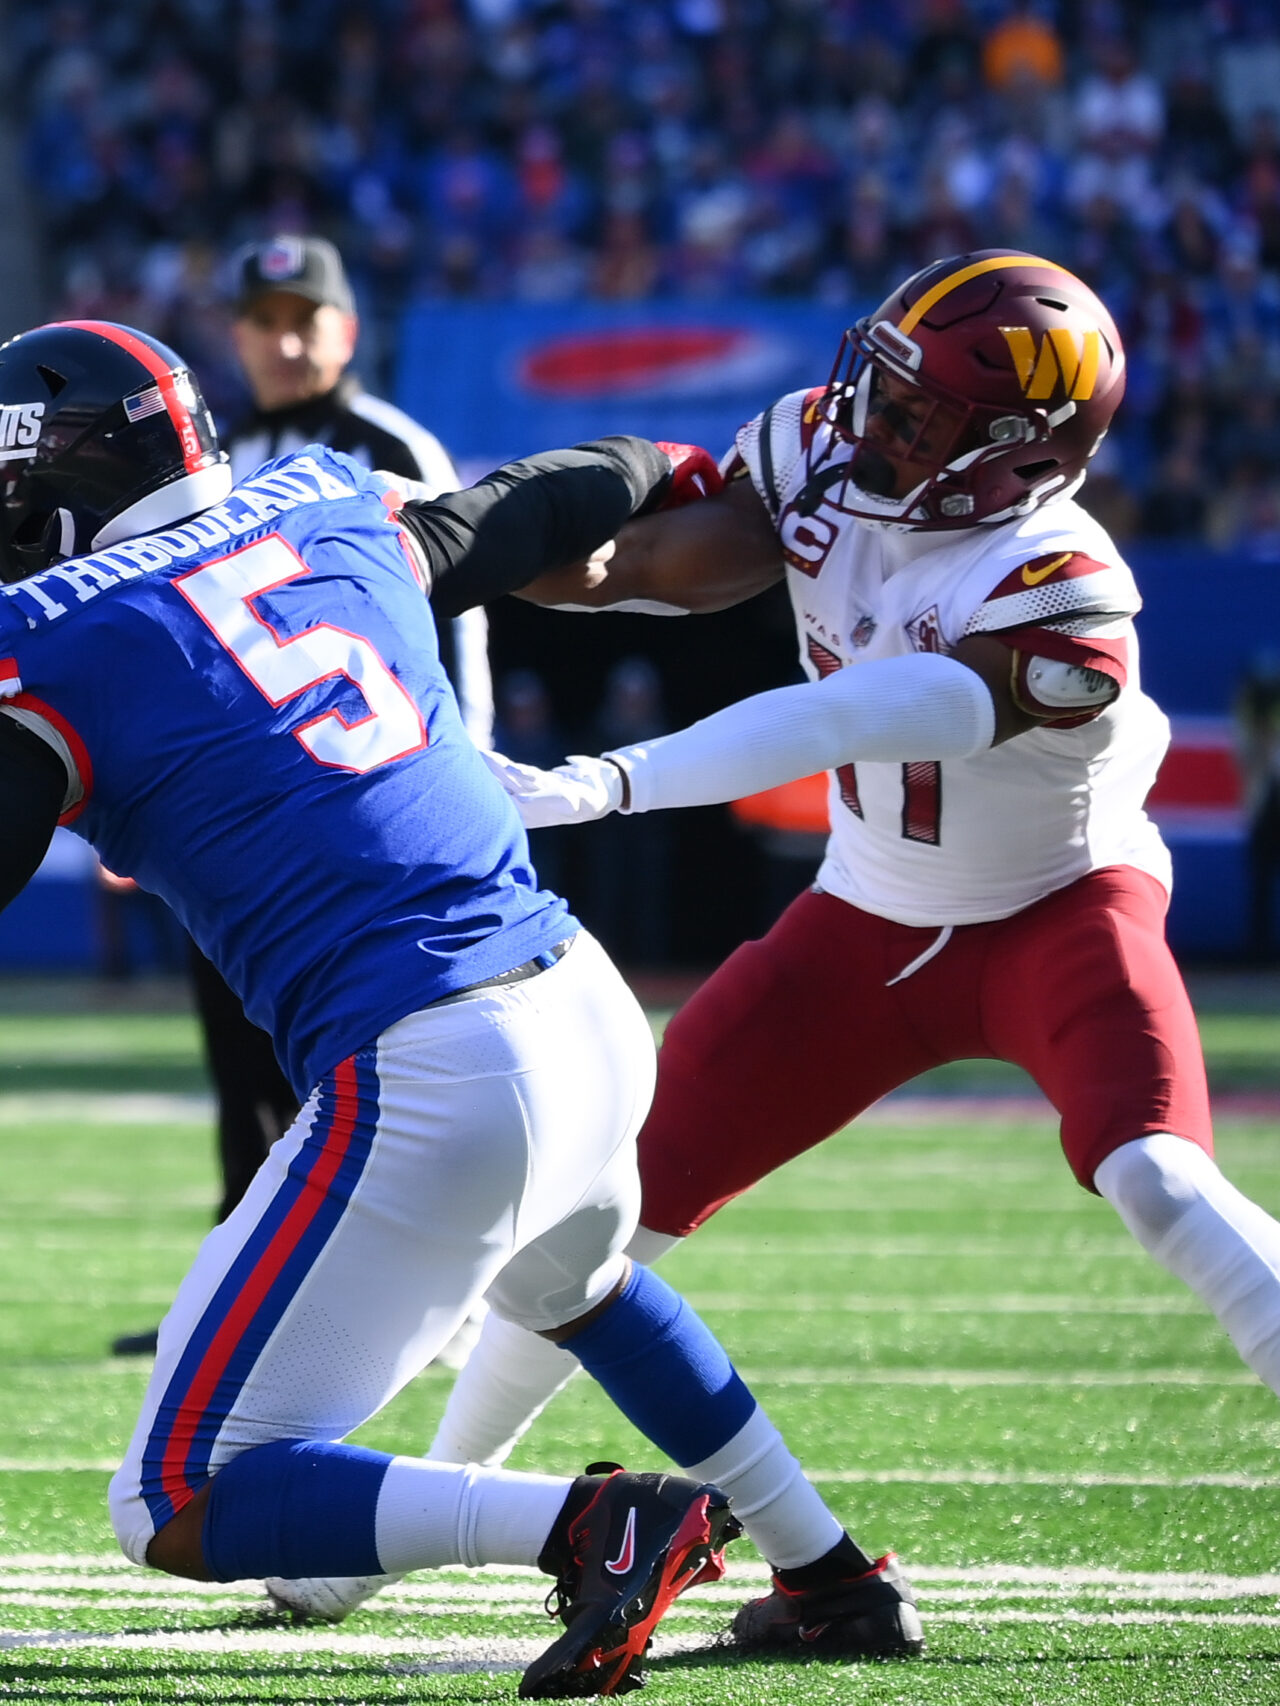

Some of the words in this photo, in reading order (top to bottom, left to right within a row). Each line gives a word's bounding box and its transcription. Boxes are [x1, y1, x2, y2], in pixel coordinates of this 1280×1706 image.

[999, 326, 1099, 400] W
[182, 426, 197, 457] 5
[1, 456, 358, 629] THIBODEAUX
[781, 511, 831, 562] C
[171, 531, 427, 774] 5
